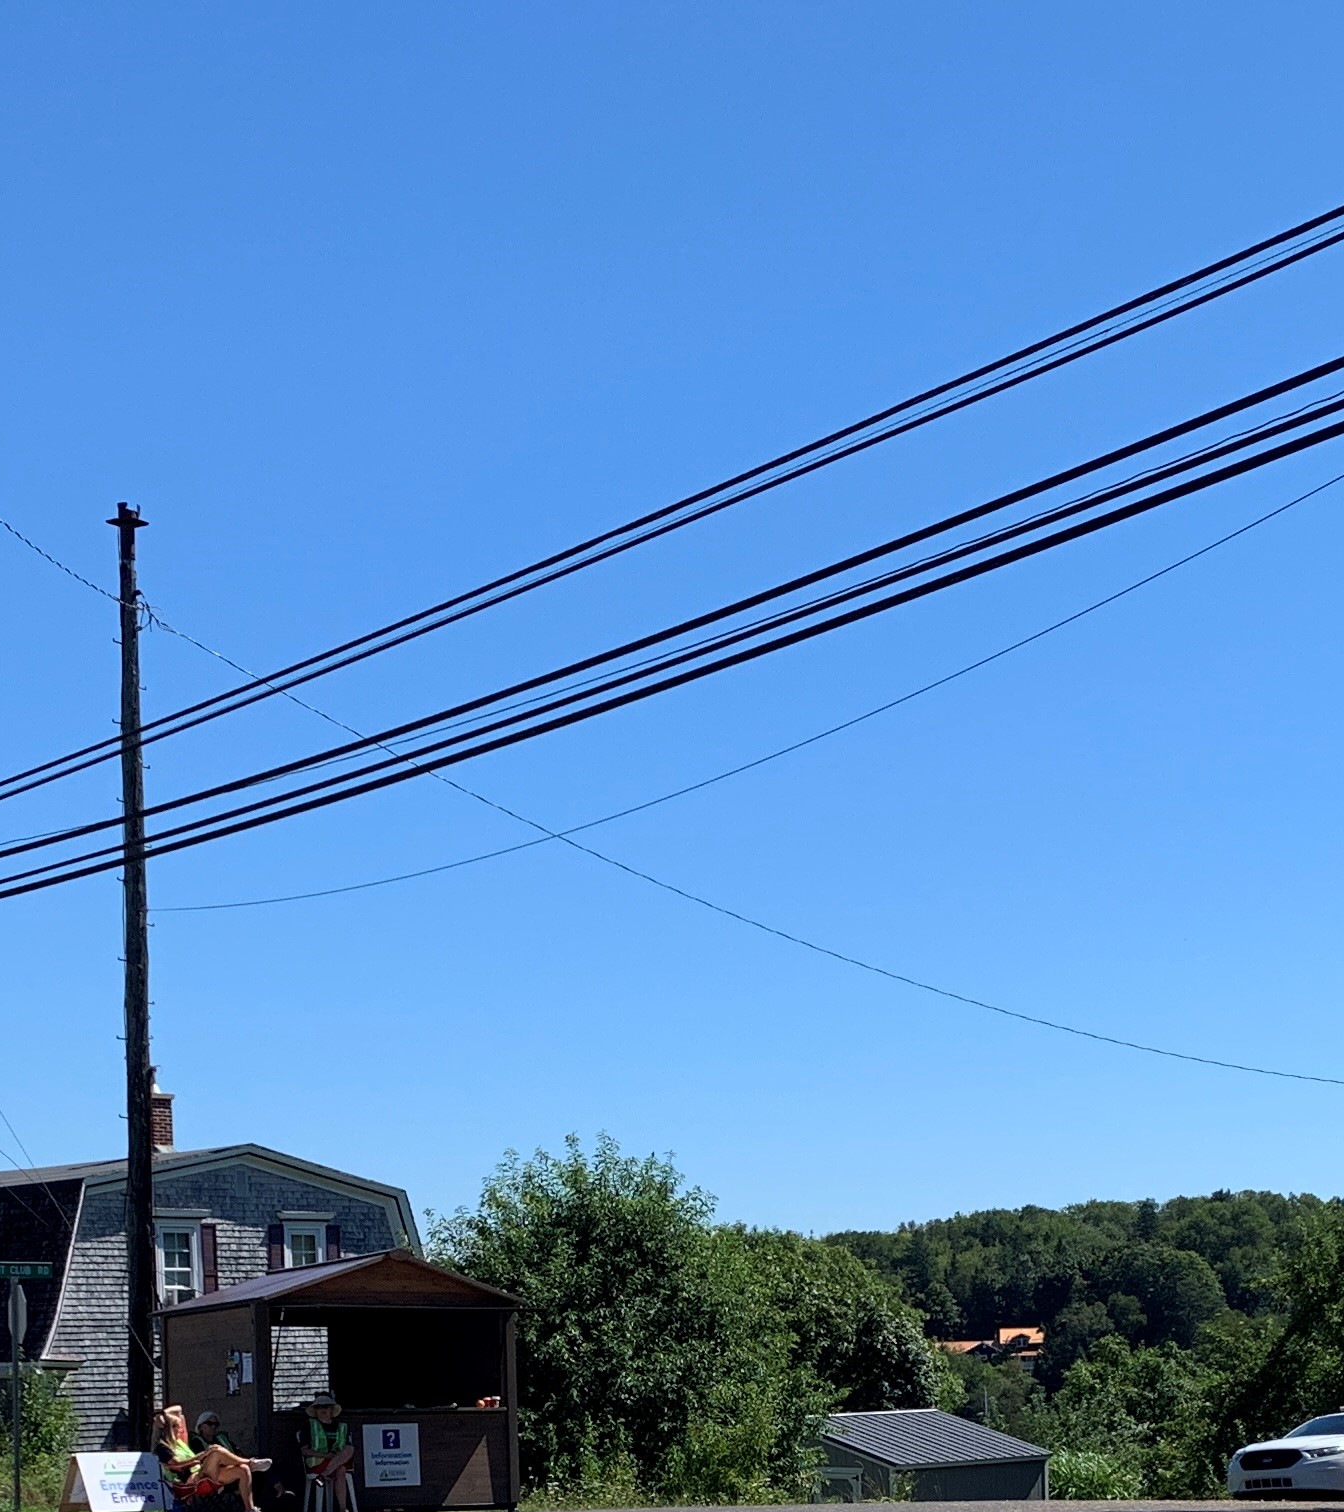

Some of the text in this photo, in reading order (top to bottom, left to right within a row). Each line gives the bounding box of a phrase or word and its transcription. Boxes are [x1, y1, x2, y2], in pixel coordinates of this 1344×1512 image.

[9, 1265, 32, 1275] CLUB
[37, 1266, 49, 1275] RD
[99, 1479, 159, 1491] Entrance
